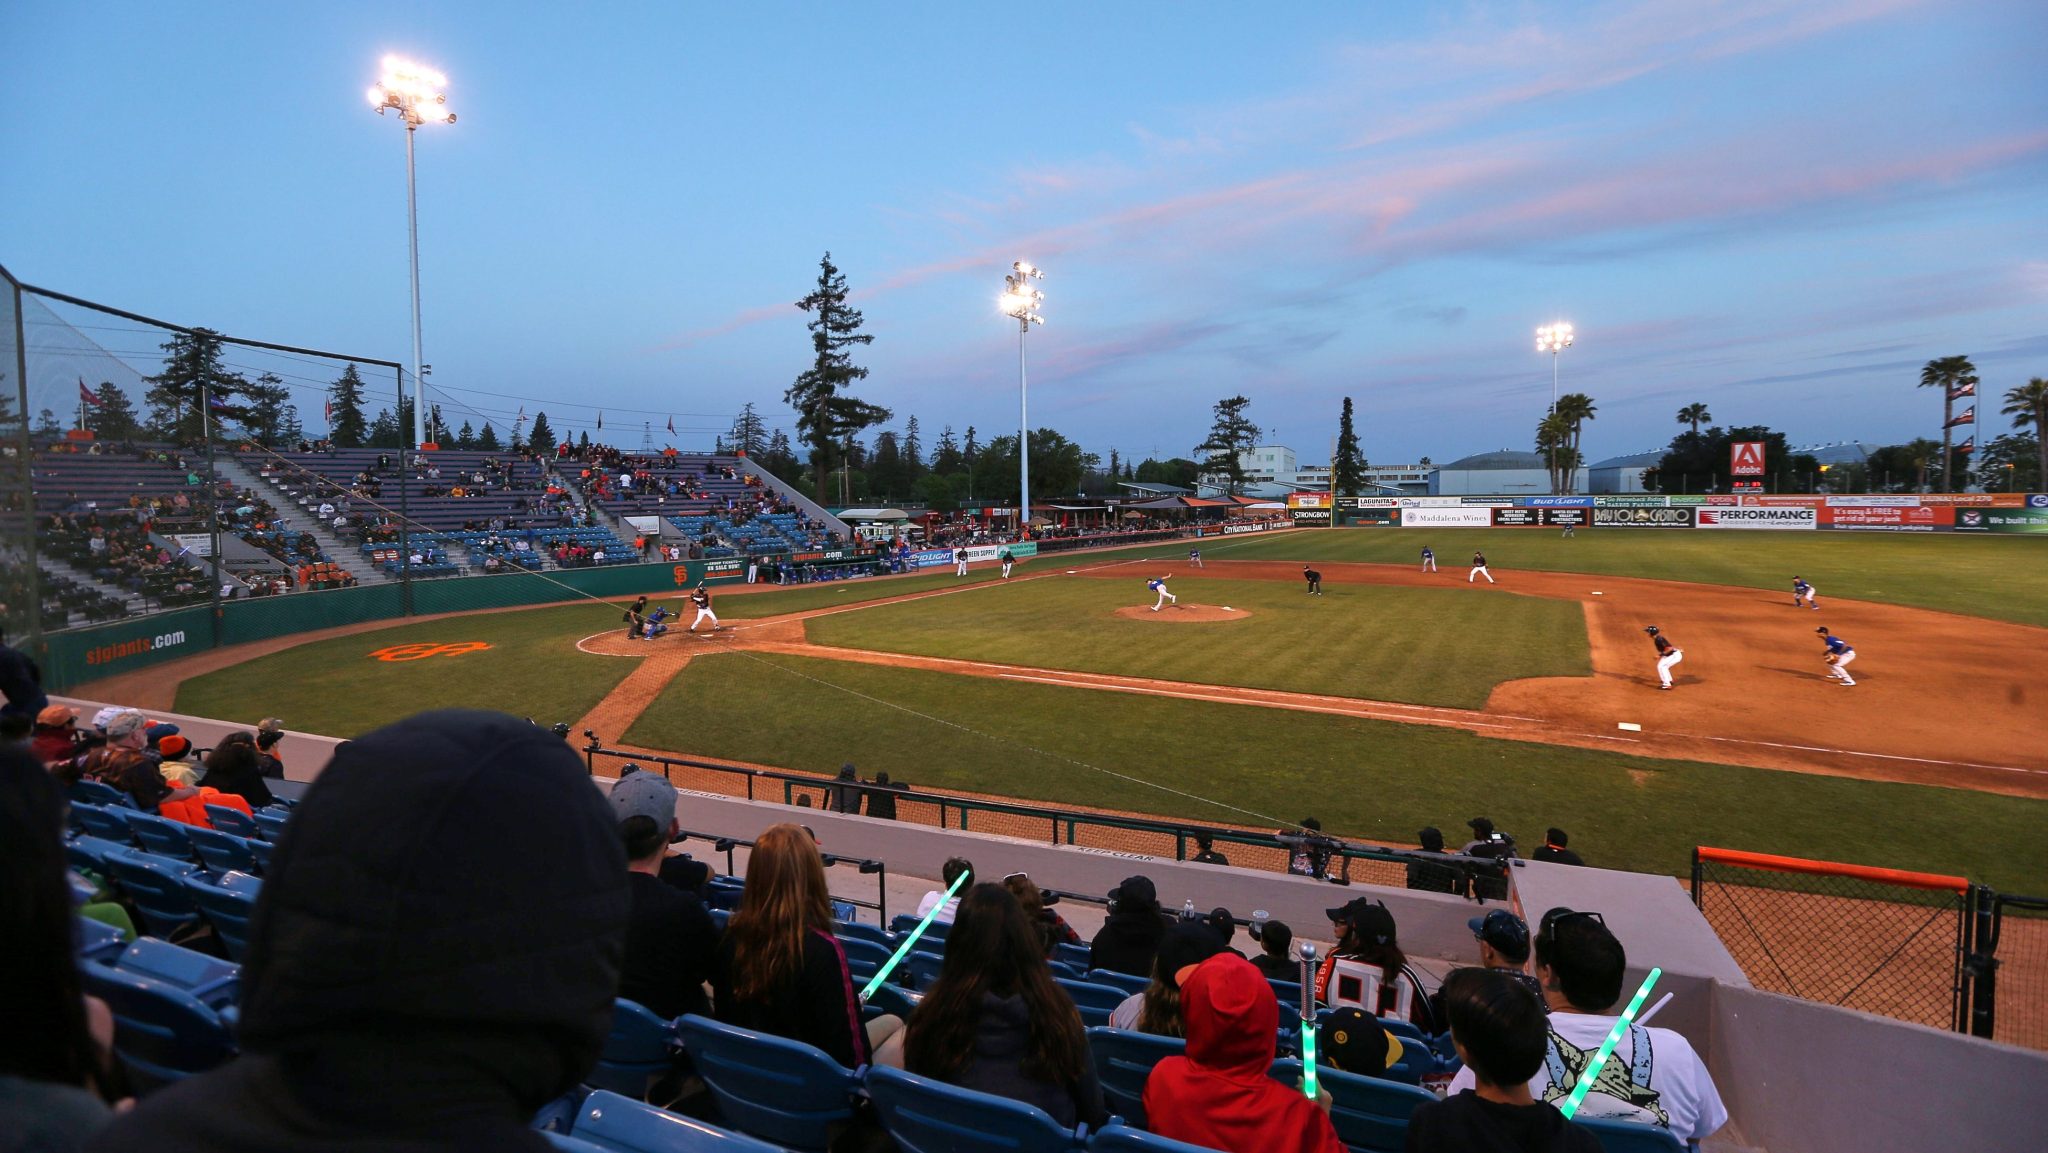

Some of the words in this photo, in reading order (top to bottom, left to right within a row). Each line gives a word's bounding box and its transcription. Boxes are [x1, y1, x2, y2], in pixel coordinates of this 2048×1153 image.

[1735, 466, 1761, 474] Adobe
[1294, 511, 1330, 519] STRONGBOW
[1420, 514, 1461, 522] Maddalena
[1594, 508, 1613, 522] BAY
[1720, 510, 1814, 520] PERFORMANCE
[1252, 523, 1264, 531] BANK
[928, 551, 952, 560] LIGHT
[980, 549, 996, 557] SUPPLY
[86, 630, 186, 665] sjgiants.com
[1077, 847, 1112, 855] KEEP
[1112, 852, 1155, 861] CLEAR
